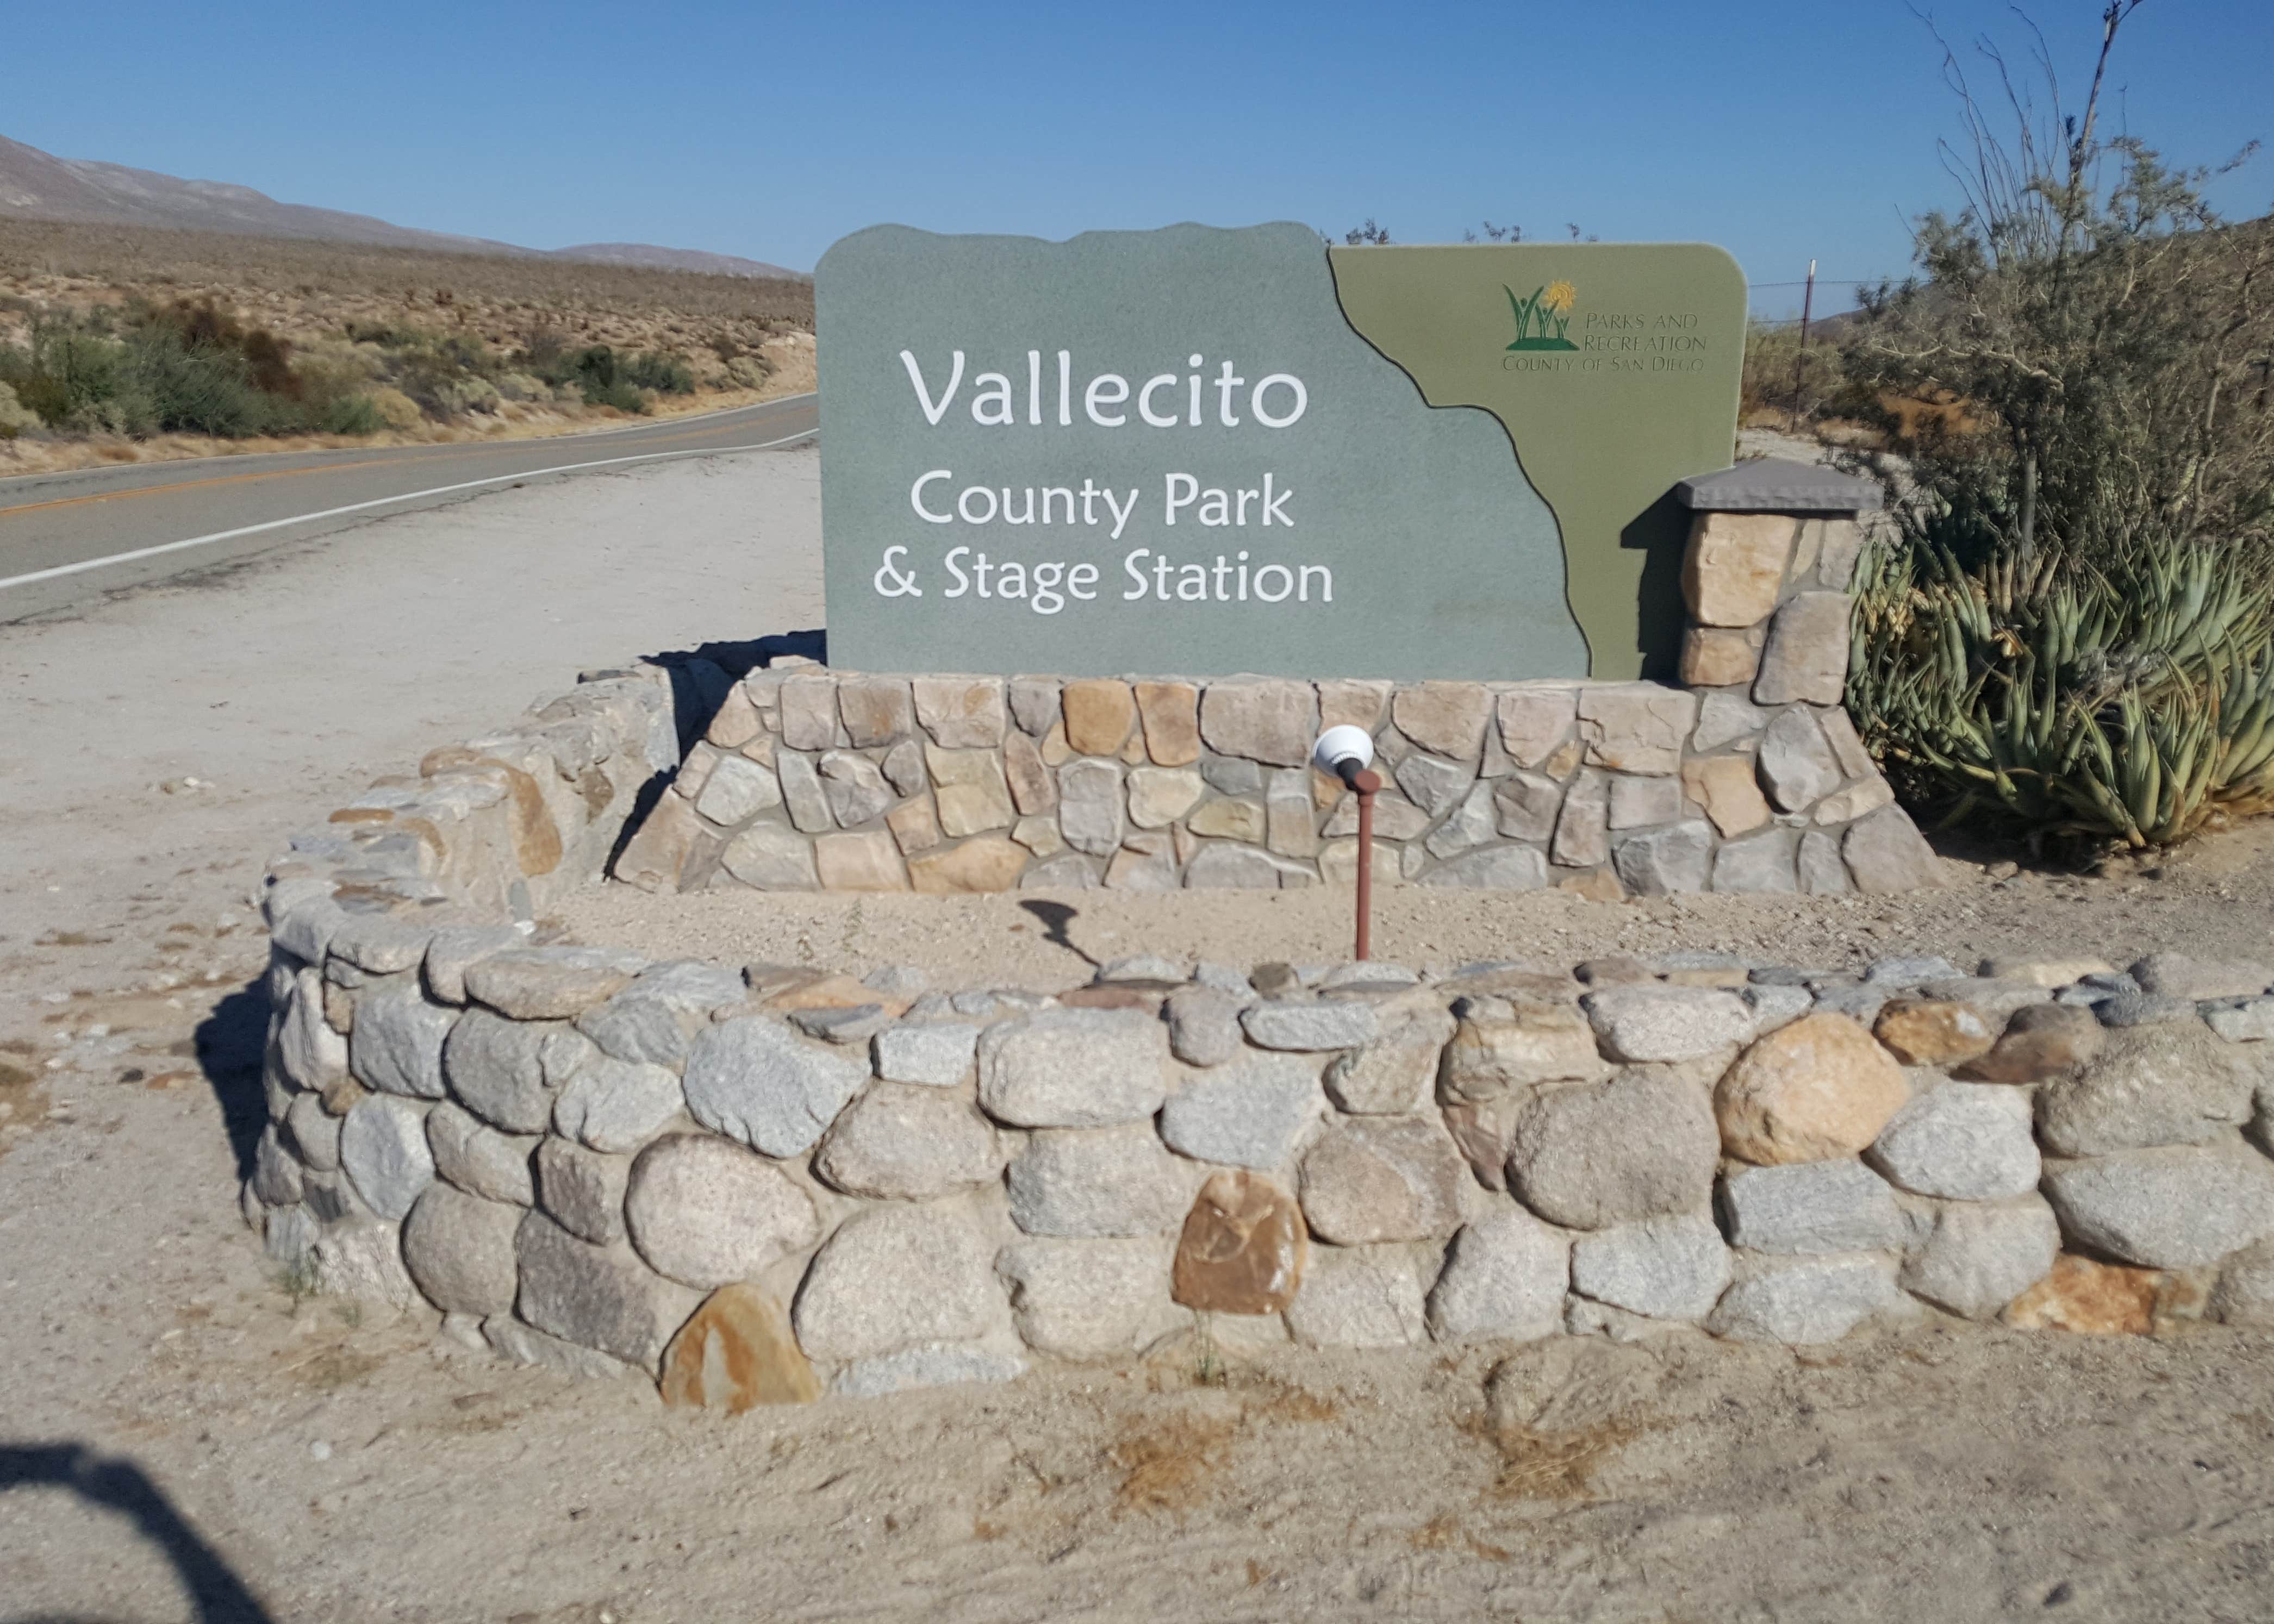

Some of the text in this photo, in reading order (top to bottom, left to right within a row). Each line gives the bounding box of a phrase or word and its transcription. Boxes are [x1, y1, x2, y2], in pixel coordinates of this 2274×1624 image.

[1585, 313, 1698, 329] PARKS AND
[1585, 334, 1707, 352] RECREATION
[1503, 356, 1704, 371] COUNTY OF SAN DIEGO
[900, 349, 1307, 428] Vallecito
[911, 470, 1295, 540] County Park
[874, 545, 1334, 615] & Stage Station
